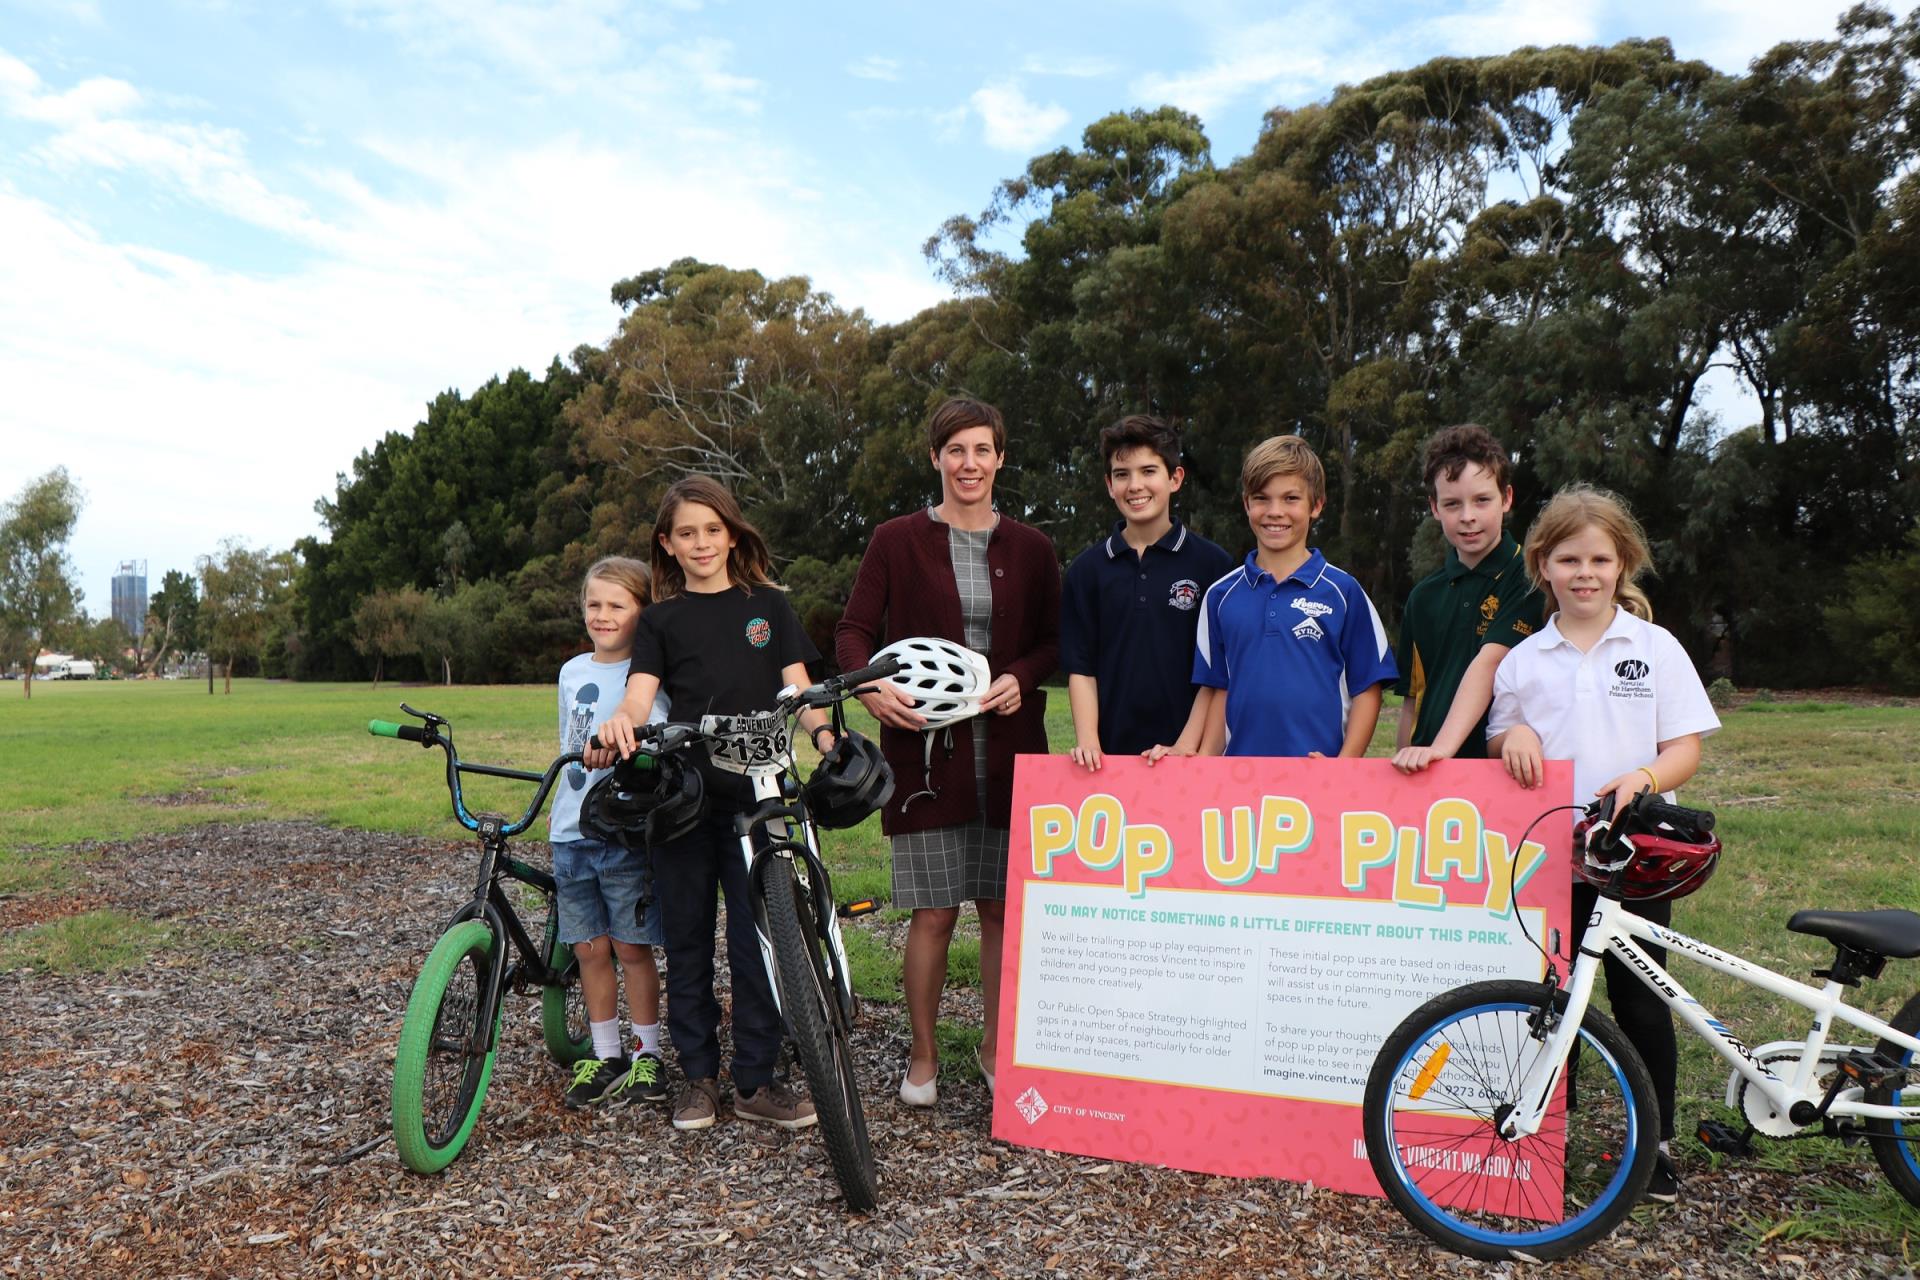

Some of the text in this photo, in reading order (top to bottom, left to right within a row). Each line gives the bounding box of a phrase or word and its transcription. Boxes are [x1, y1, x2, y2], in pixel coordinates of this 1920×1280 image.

[713, 727, 787, 761] 2136
[1030, 794, 1546, 920] POP UP PLAY
[1043, 903, 1512, 946] YOU MAY NOTICE SOMETHING A LITTLE DIFFERENT ABOUT THIS PARK.
[1041, 931, 1252, 955] We will be trialling pop up play equipment in
[1040, 958, 1243, 985] children and young people to use our open
[1041, 946, 1245, 971] some key locations across Vincent to inspire
[1269, 947, 1506, 976] These initial pop ups are based on ideas put
[1609, 935, 1678, 998] RADIUS
[1039, 973, 1143, 991] spaces more creatively.
[1268, 961, 1306, 974] forward
[1310, 964, 1322, 978] by
[1326, 968, 1342, 976] our
[1346, 970, 1407, 984] community.
[1411, 972, 1429, 983] We
[1433, 974, 1460, 988] hope
[1268, 977, 1283, 986] will
[1287, 979, 1314, 989] assist
[1317, 982, 1329, 990] us
[1333, 981, 1341, 991] in
[1345, 982, 1390, 998] planning
[1394, 988, 1422, 998] more
[1267, 993, 1371, 1009] spaces in the future.
[1036, 1015, 1058, 1026] gaps
[1061, 1016, 1069, 1025] in
[1080, 1019, 1115, 1030] number
[1118, 1022, 1128, 1031] of
[1130, 1024, 1209, 1040] neighbourhoods
[1212, 1032, 1231, 1042] and
[1037, 1000, 1246, 1030] Our Public Open Space Strategy highlighted
[1035, 1040, 1141, 1062] children and teenagers.
[1044, 1027, 1061, 1038] lack
[1064, 1030, 1073, 1039] of
[1075, 1031, 1094, 1044] play
[1097, 1035, 1130, 1047] spaces,
[1134, 1039, 1186, 1054] particularly
[1189, 1043, 1201, 1053] for
[1205, 1045, 1231, 1056] older
[1266, 1021, 1277, 1032] To
[1280, 1023, 1305, 1035] share
[1310, 1028, 1332, 1039] your
[1336, 1028, 1381, 1044] thoughts
[1473, 1041, 1501, 1054] kinds
[1264, 1053, 1294, 1063] would
[1298, 1054, 1315, 1065] like
[1318, 1057, 1328, 1067] to
[1331, 1060, 1349, 1069] see
[1353, 1060, 1361, 1070] in
[1265, 1037, 1275, 1046] of
[1278, 1040, 1298, 1052] pop
[1302, 1042, 1314, 1054] up
[1317, 1042, 1338, 1056] play
[1342, 1046, 1353, 1054] or
[1480, 1060, 1499, 1071] you
[1446, 1085, 1473, 1098] 9273
[1053, 1104, 1125, 1122] CITY OF VINCENT
